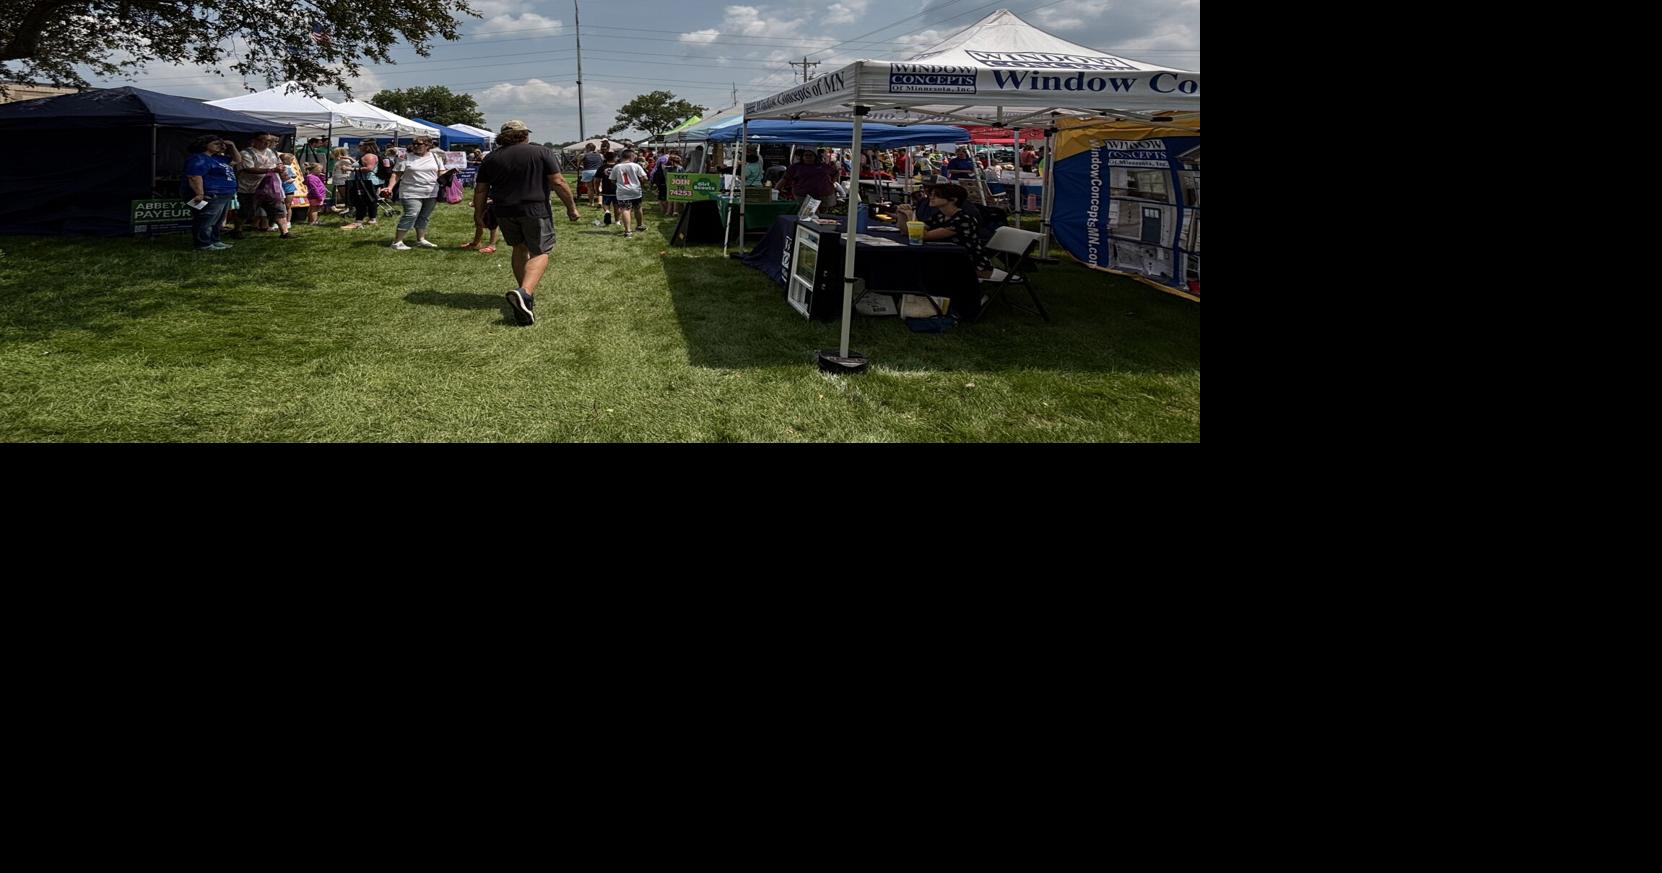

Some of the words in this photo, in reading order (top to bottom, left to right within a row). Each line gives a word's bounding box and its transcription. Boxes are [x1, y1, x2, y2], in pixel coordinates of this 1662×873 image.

[894, 63, 973, 74] WINDOW
[892, 75, 975, 85] CONCEPTS
[992, 70, 1138, 93] Window
[777, 86, 812, 105] Concepts
[812, 78, 823, 97] of
[824, 71, 845, 94] MN
[1108, 151, 1168, 160] CONCEPTS
[622, 172, 631, 185] 1
[135, 201, 178, 210] ABBEY
[134, 209, 192, 220] PAYEUR
